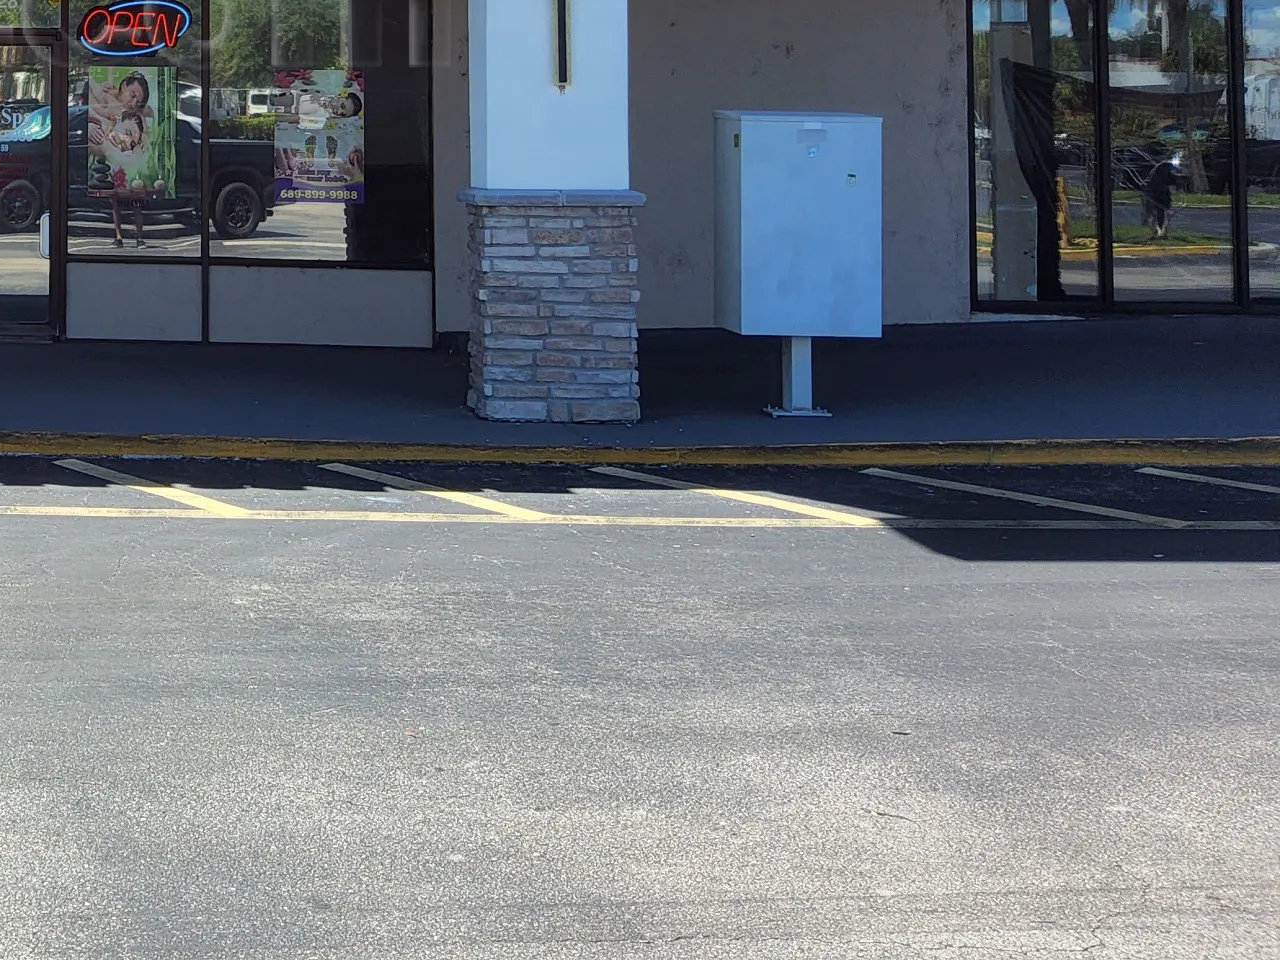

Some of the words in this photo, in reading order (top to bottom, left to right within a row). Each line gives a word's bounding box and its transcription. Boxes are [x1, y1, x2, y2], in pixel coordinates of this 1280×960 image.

[83, 8, 182, 49] OPEN
[1, 107, 32, 129] Spa
[280, 189, 358, 200] 689-899-9988
